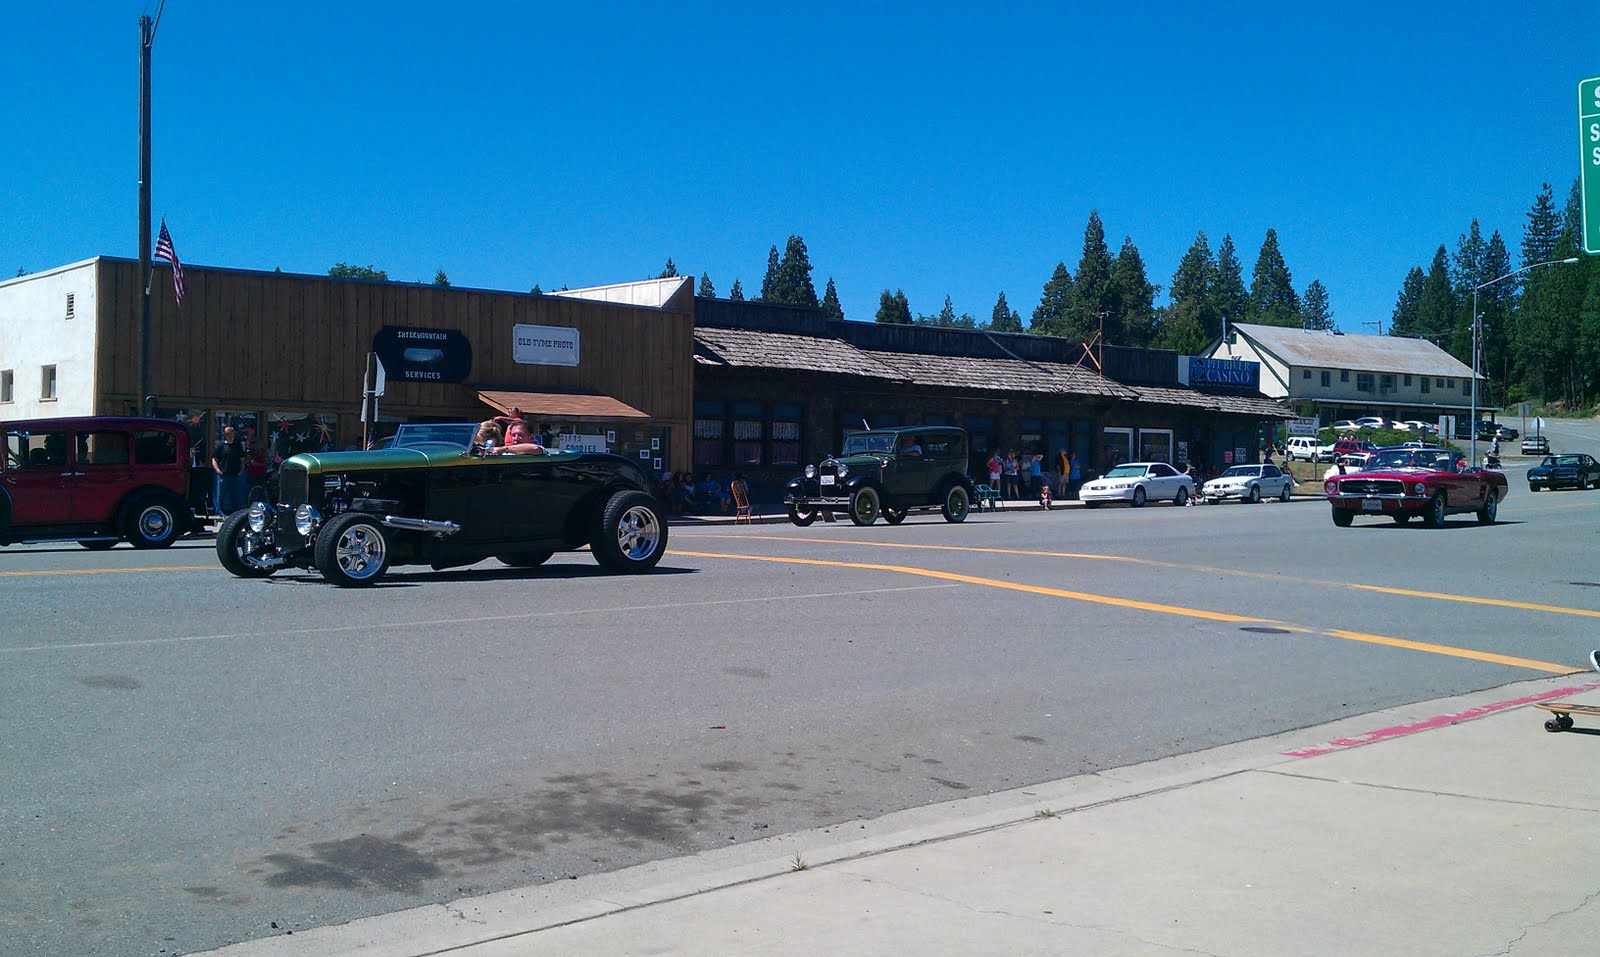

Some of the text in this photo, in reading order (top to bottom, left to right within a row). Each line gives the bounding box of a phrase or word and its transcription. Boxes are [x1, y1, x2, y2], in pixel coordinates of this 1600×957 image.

[397, 331, 447, 340] INTERMOUNTAIN
[518, 337, 574, 349] OLD TYME PHOTO
[1223, 360, 1250, 371] RIVER
[405, 371, 441, 380] SERVICES
[1206, 369, 1250, 384] CASINO
[560, 434, 582, 442] GIFTS
